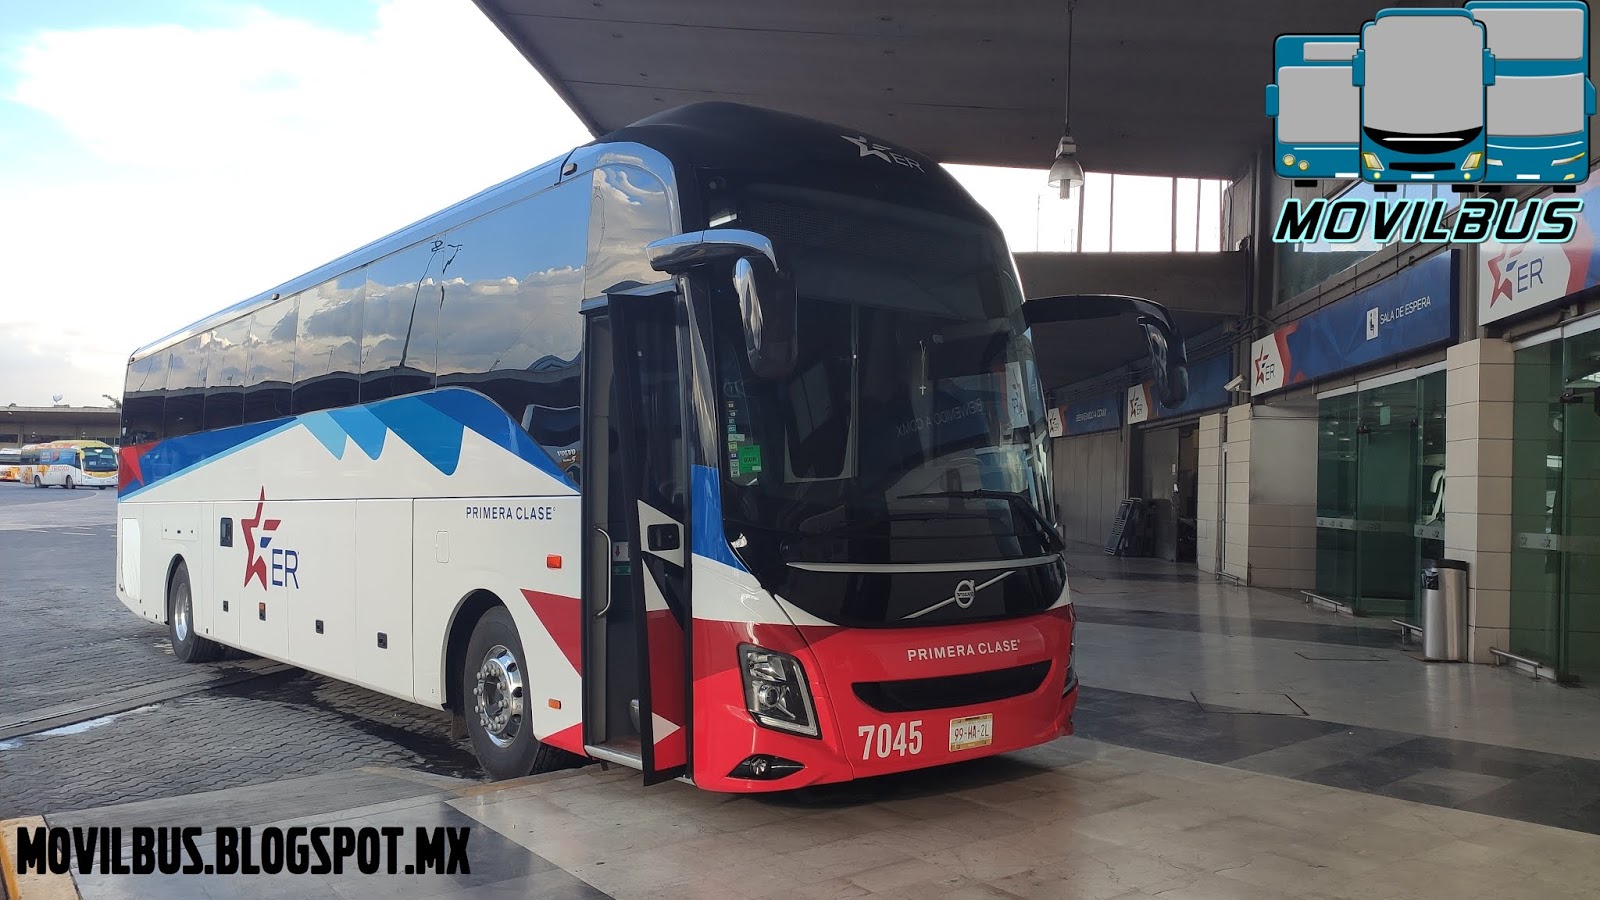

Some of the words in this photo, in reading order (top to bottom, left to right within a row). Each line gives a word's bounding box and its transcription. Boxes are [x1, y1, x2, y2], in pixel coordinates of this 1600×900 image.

[889, 152, 925, 173] ER
[1517, 257, 1544, 293] ER
[1379, 310, 1395, 325] SALA
[1395, 305, 1405, 319] DE
[1404, 295, 1431, 316] ESPERA
[466, 507, 513, 520] PRIMERA
[272, 549, 299, 589] ER
[907, 644, 975, 662] PRIMERA
[858, 720, 923, 760] 7045
